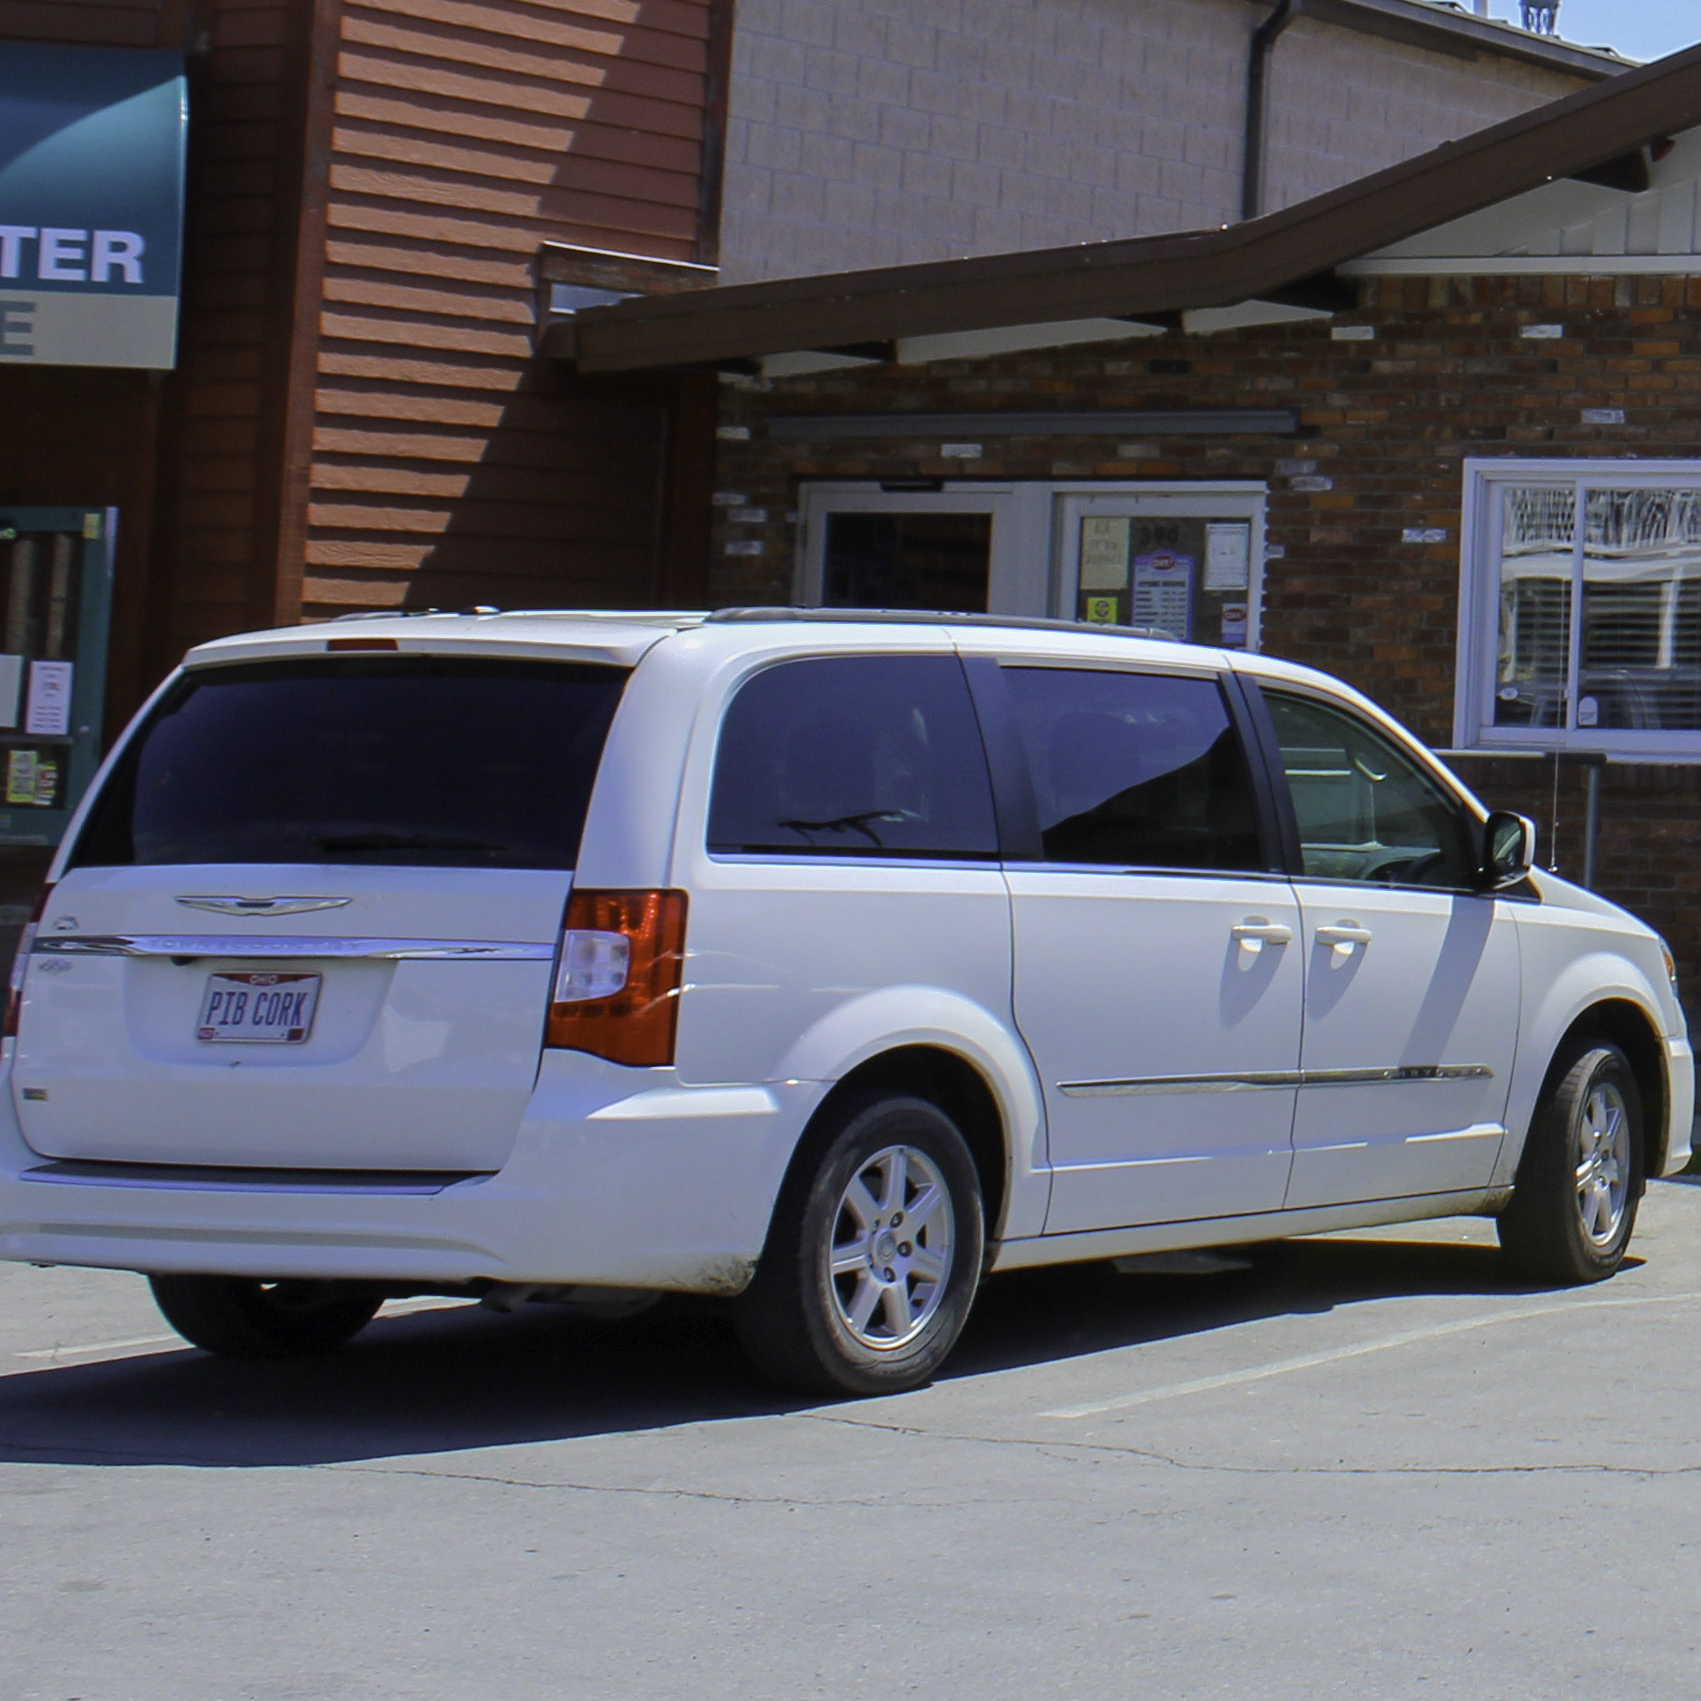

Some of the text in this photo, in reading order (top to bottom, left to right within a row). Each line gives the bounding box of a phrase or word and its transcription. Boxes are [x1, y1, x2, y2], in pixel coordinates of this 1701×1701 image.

[0, 225, 146, 283] TER
[205, 991, 308, 1026] PIB CORK
